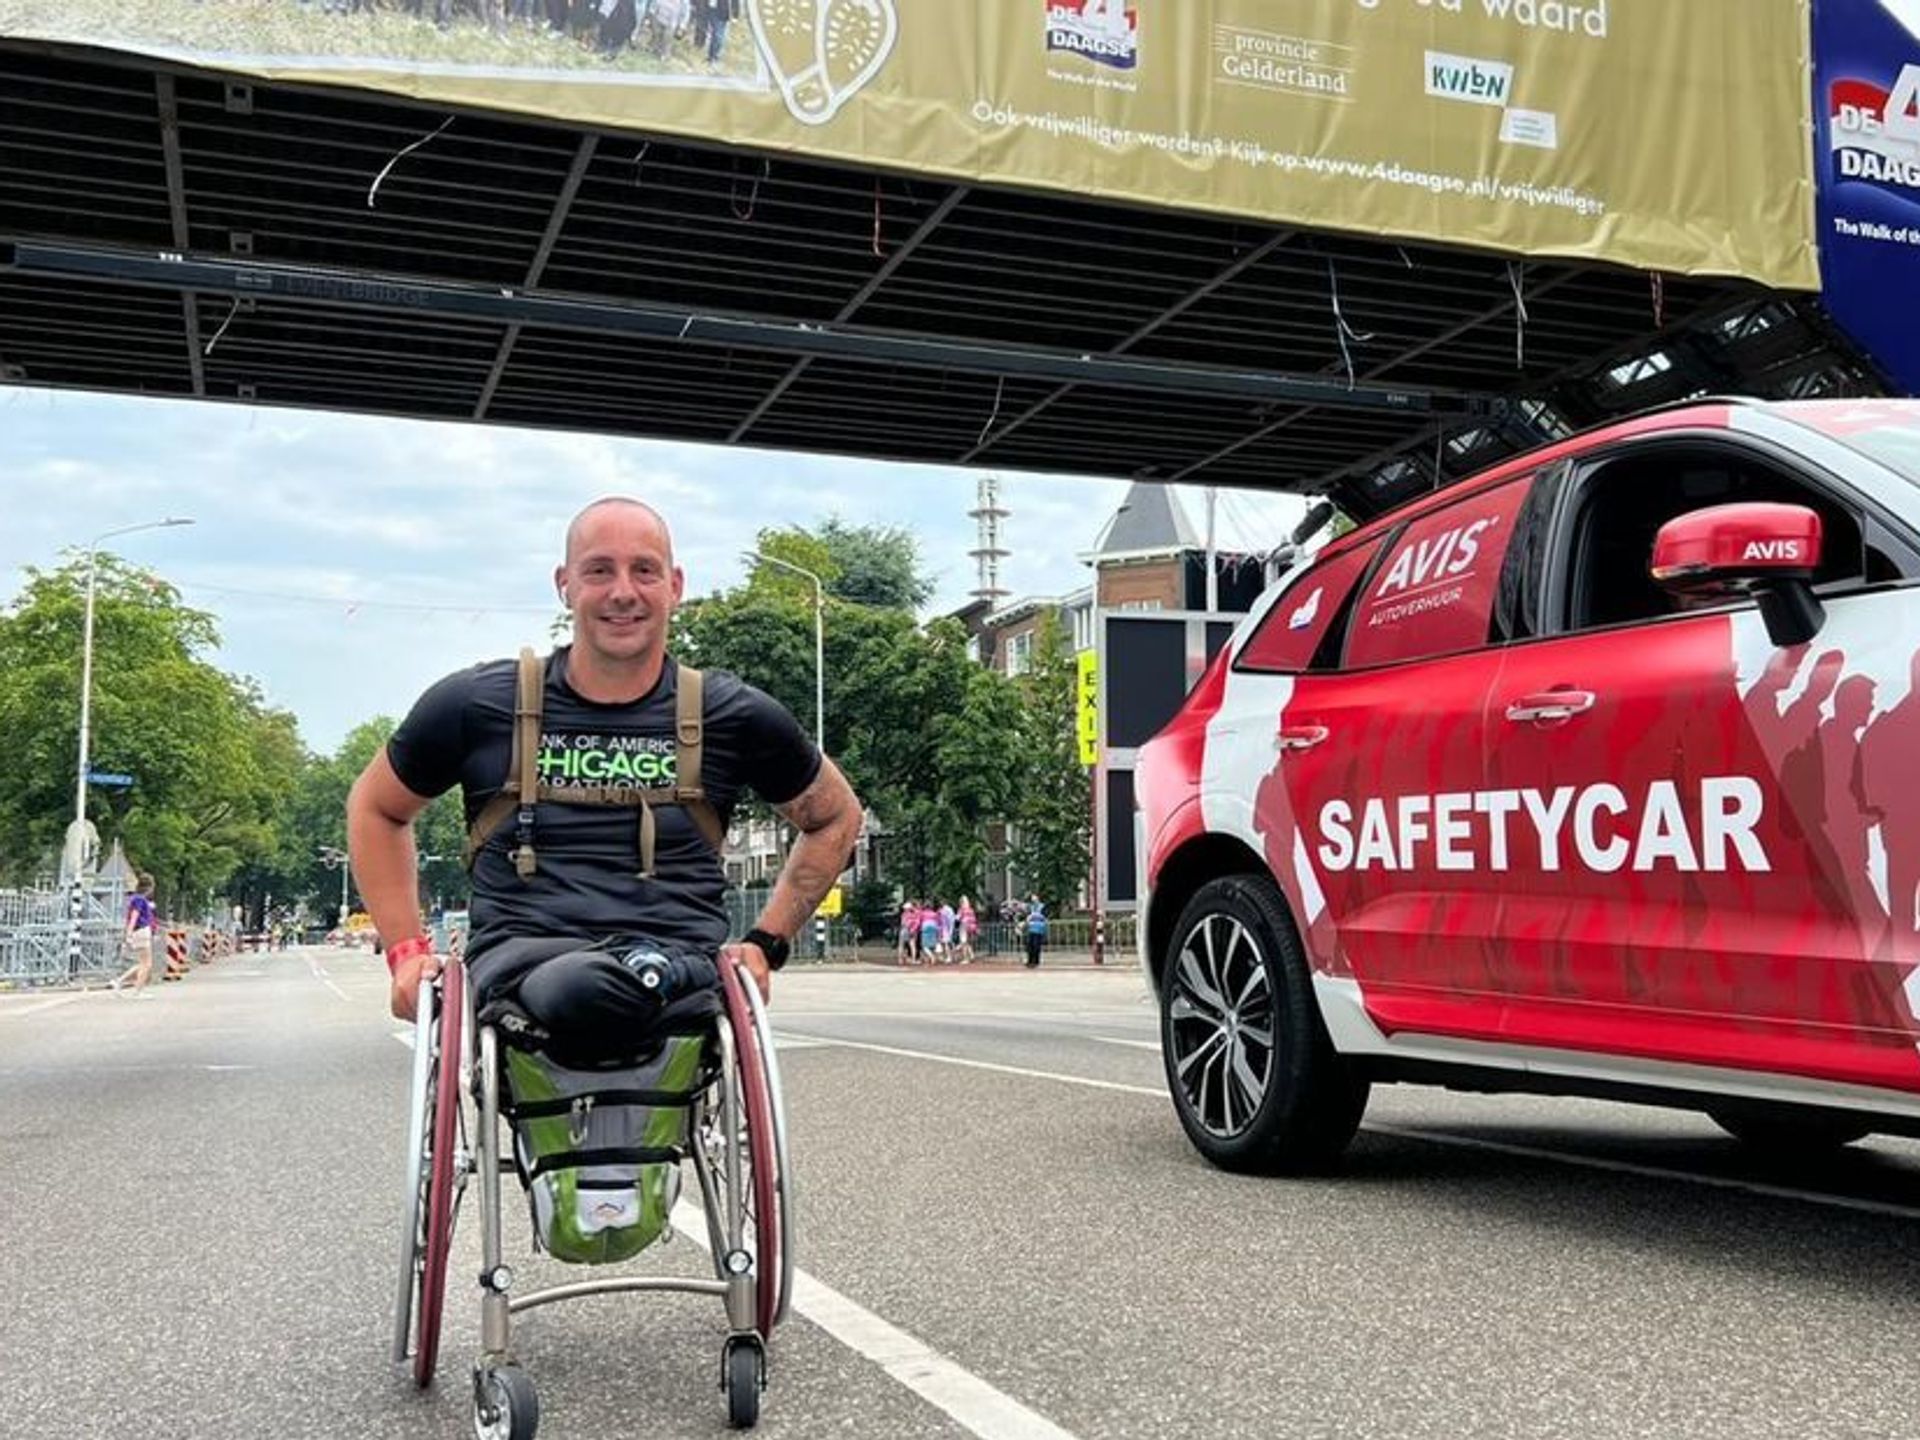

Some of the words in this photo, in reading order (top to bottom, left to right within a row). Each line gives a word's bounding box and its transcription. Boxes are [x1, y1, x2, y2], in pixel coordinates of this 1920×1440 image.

[1053, 7, 1082, 22] DE
[1481, 0, 1607, 38] waard
[1053, 32, 1131, 58] DAAGSE
[1235, 34, 1319, 61] provincie
[1222, 55, 1347, 93] Gelderland
[1840, 103, 1882, 134] DE
[972, 101, 1018, 125] Ook
[1024, 112, 1131, 148] vrijwilliger
[1138, 131, 1223, 157] worden?
[1231, 140, 1267, 167] Kijk
[1303, 155, 1605, 214] www.4daagse.nl/vrijwilliger
[1840, 149, 1920, 187] DAAG
[1834, 217, 1858, 235] The
[1859, 222, 1891, 240] Walk
[1893, 228, 1907, 243] of
[1908, 229, 1920, 246] th
[1376, 518, 1488, 597] AVIS
[1743, 541, 1799, 560] AVIS
[1368, 586, 1463, 627] AUTOVERHUUR
[1084, 671, 1098, 754] EXIT
[541, 734, 568, 749] NK
[574, 735, 600, 750] OF
[607, 736, 675, 753] AMERIC
[1318, 776, 1772, 872] SAFETYCAR
